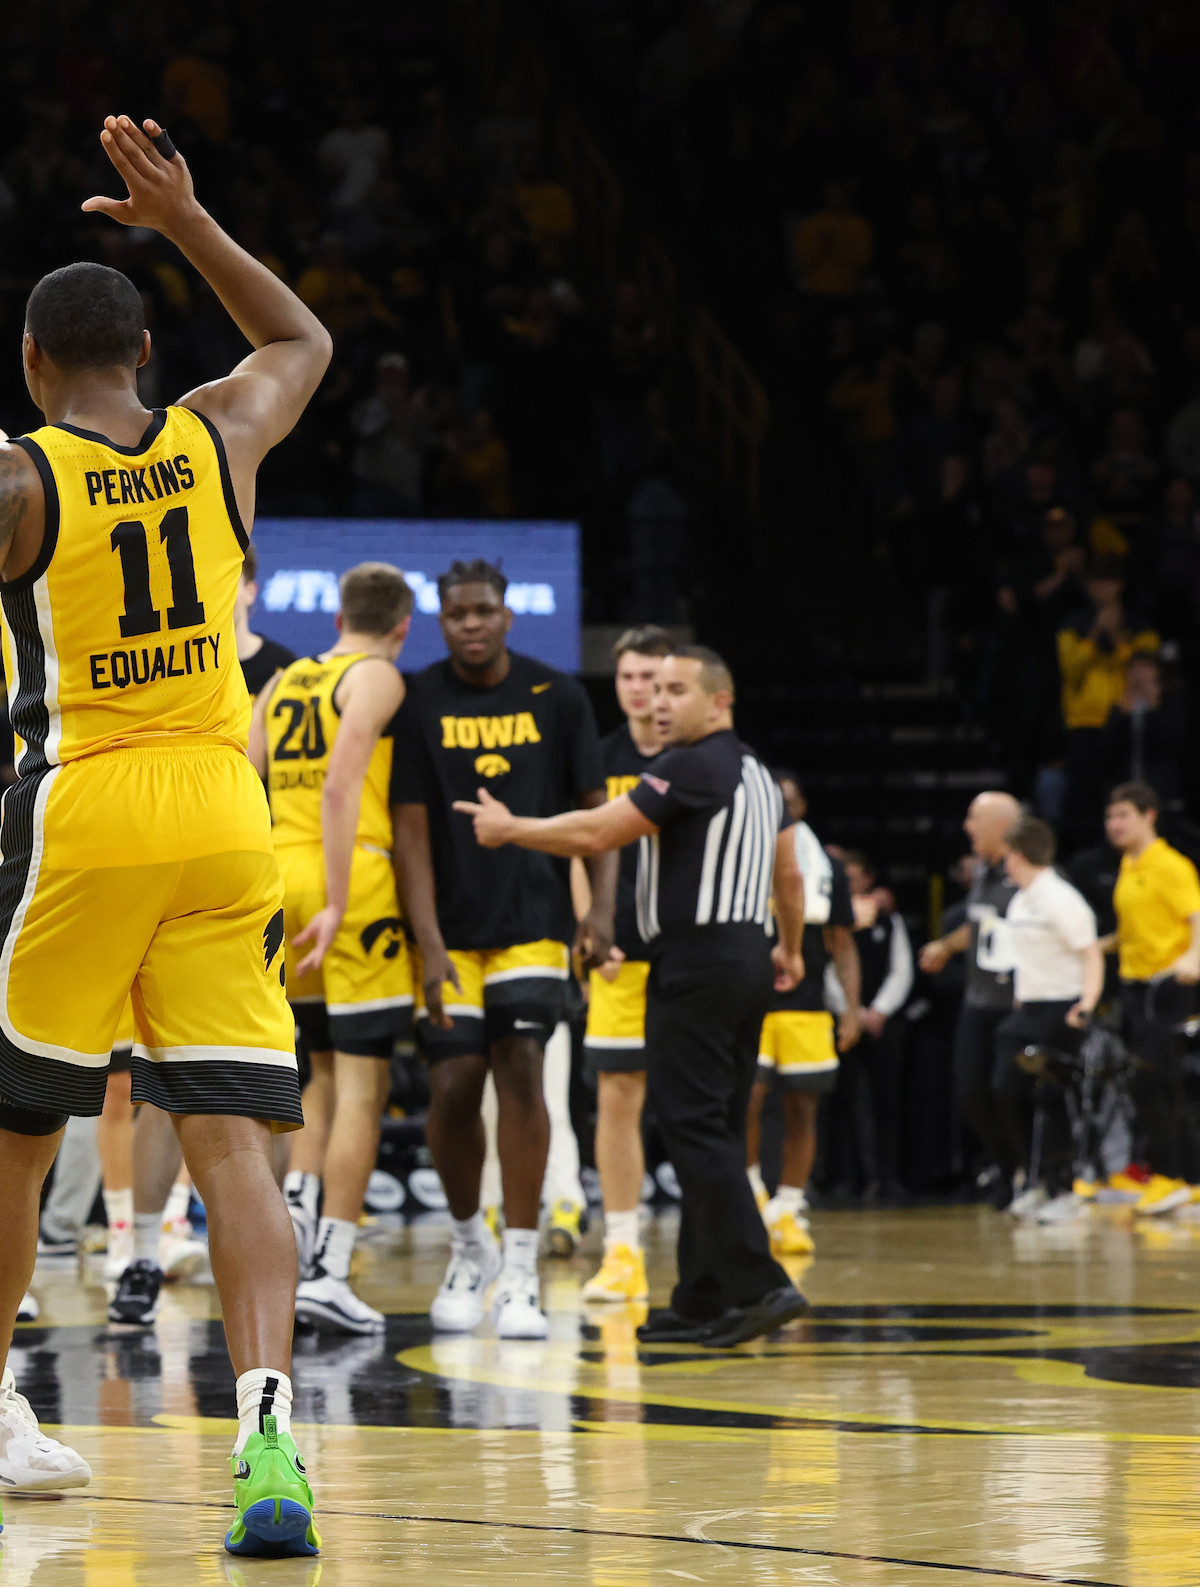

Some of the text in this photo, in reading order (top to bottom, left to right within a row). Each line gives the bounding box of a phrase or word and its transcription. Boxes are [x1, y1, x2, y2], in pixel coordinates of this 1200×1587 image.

[84, 455, 195, 506] PERKINS
[110, 506, 206, 638] 11
[89, 633, 221, 689] EQUALITY
[441, 712, 542, 750] IOWA
